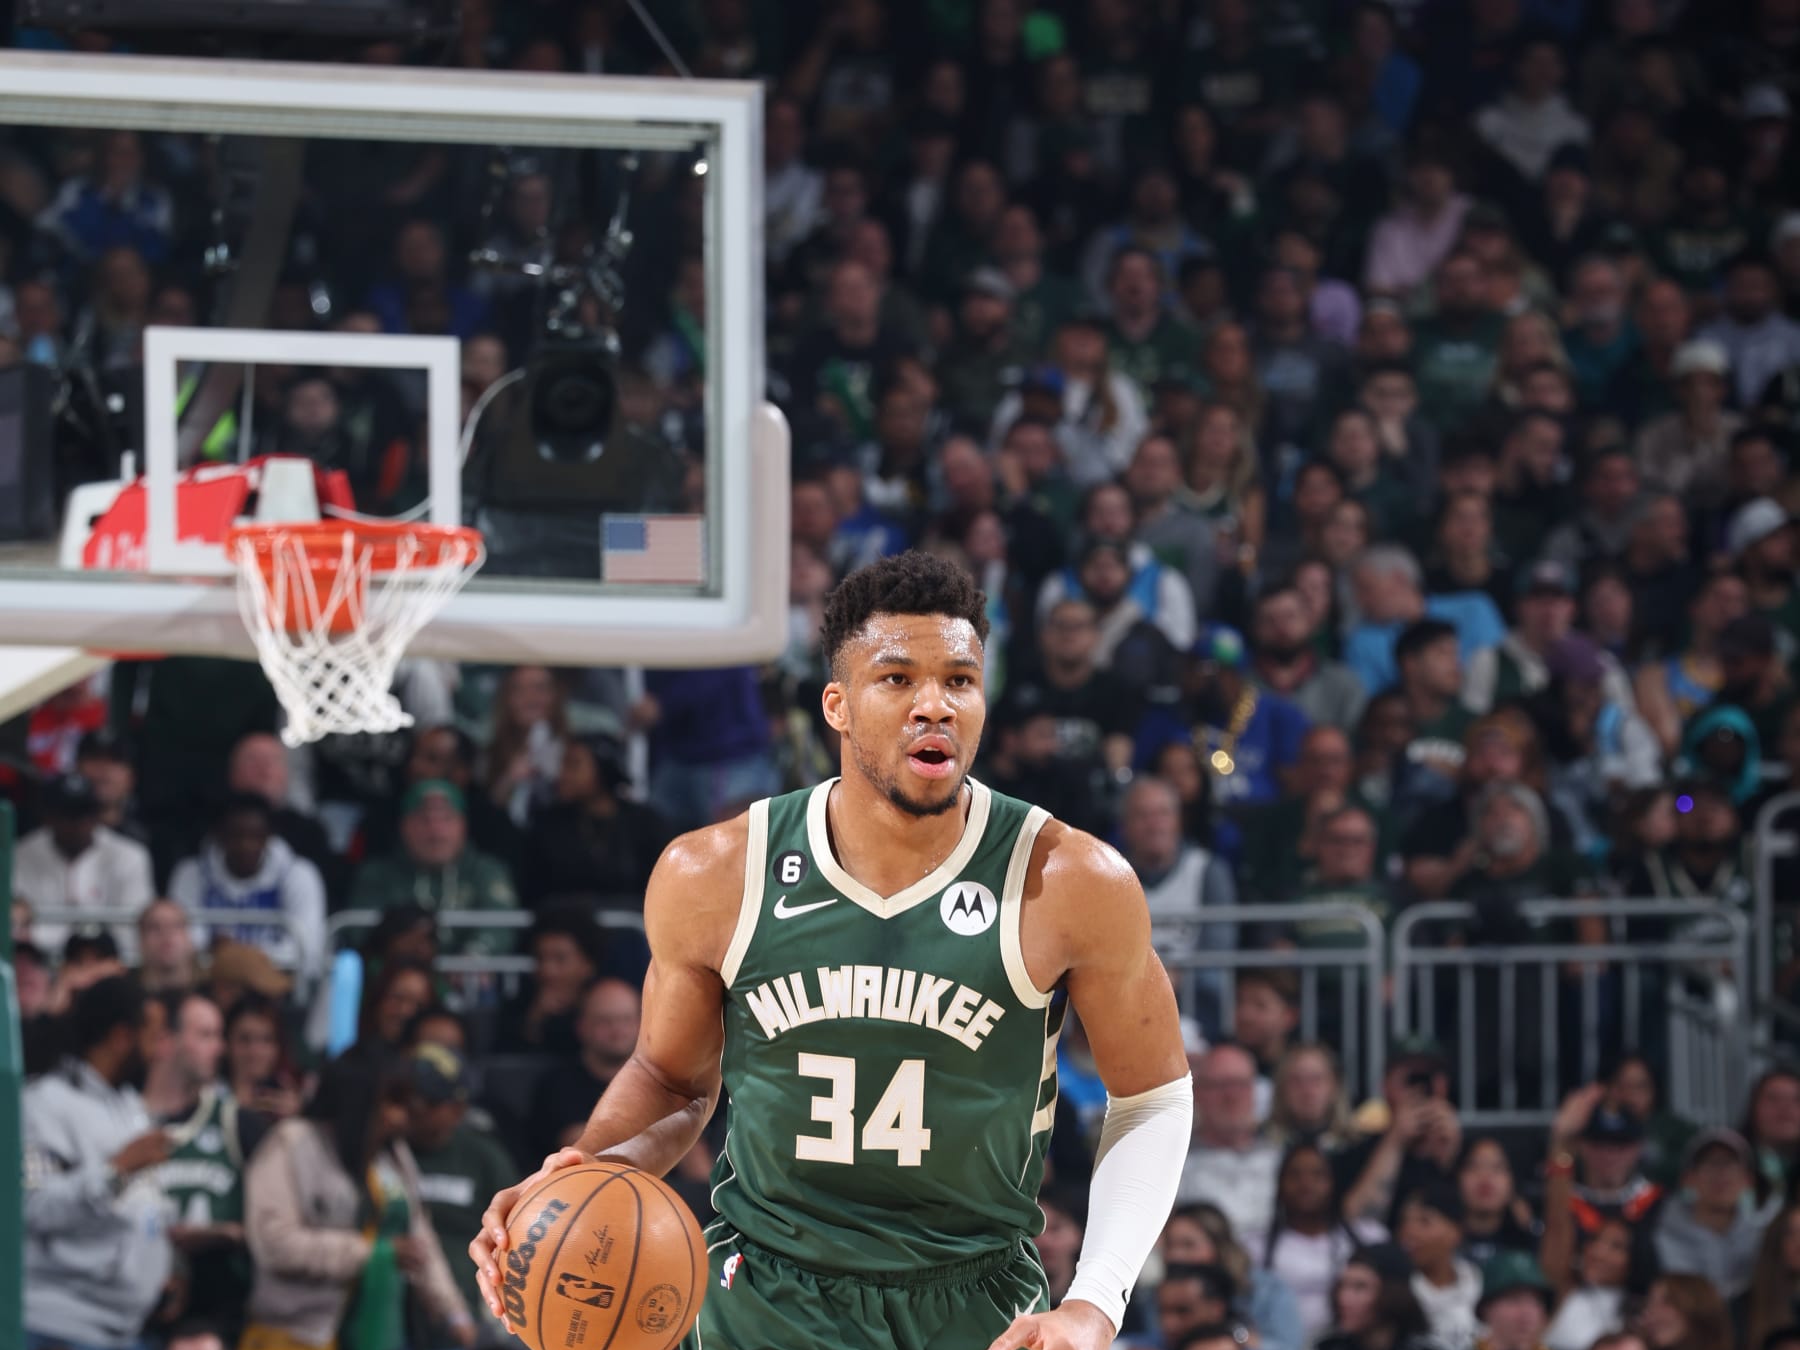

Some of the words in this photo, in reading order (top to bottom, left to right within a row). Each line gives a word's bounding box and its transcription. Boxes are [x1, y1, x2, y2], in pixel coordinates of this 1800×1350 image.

[781, 855, 802, 884] 6
[745, 965, 1005, 1052] MILWAUKEE
[795, 1052, 931, 1167] 34
[503, 1199, 570, 1328] Wilson
